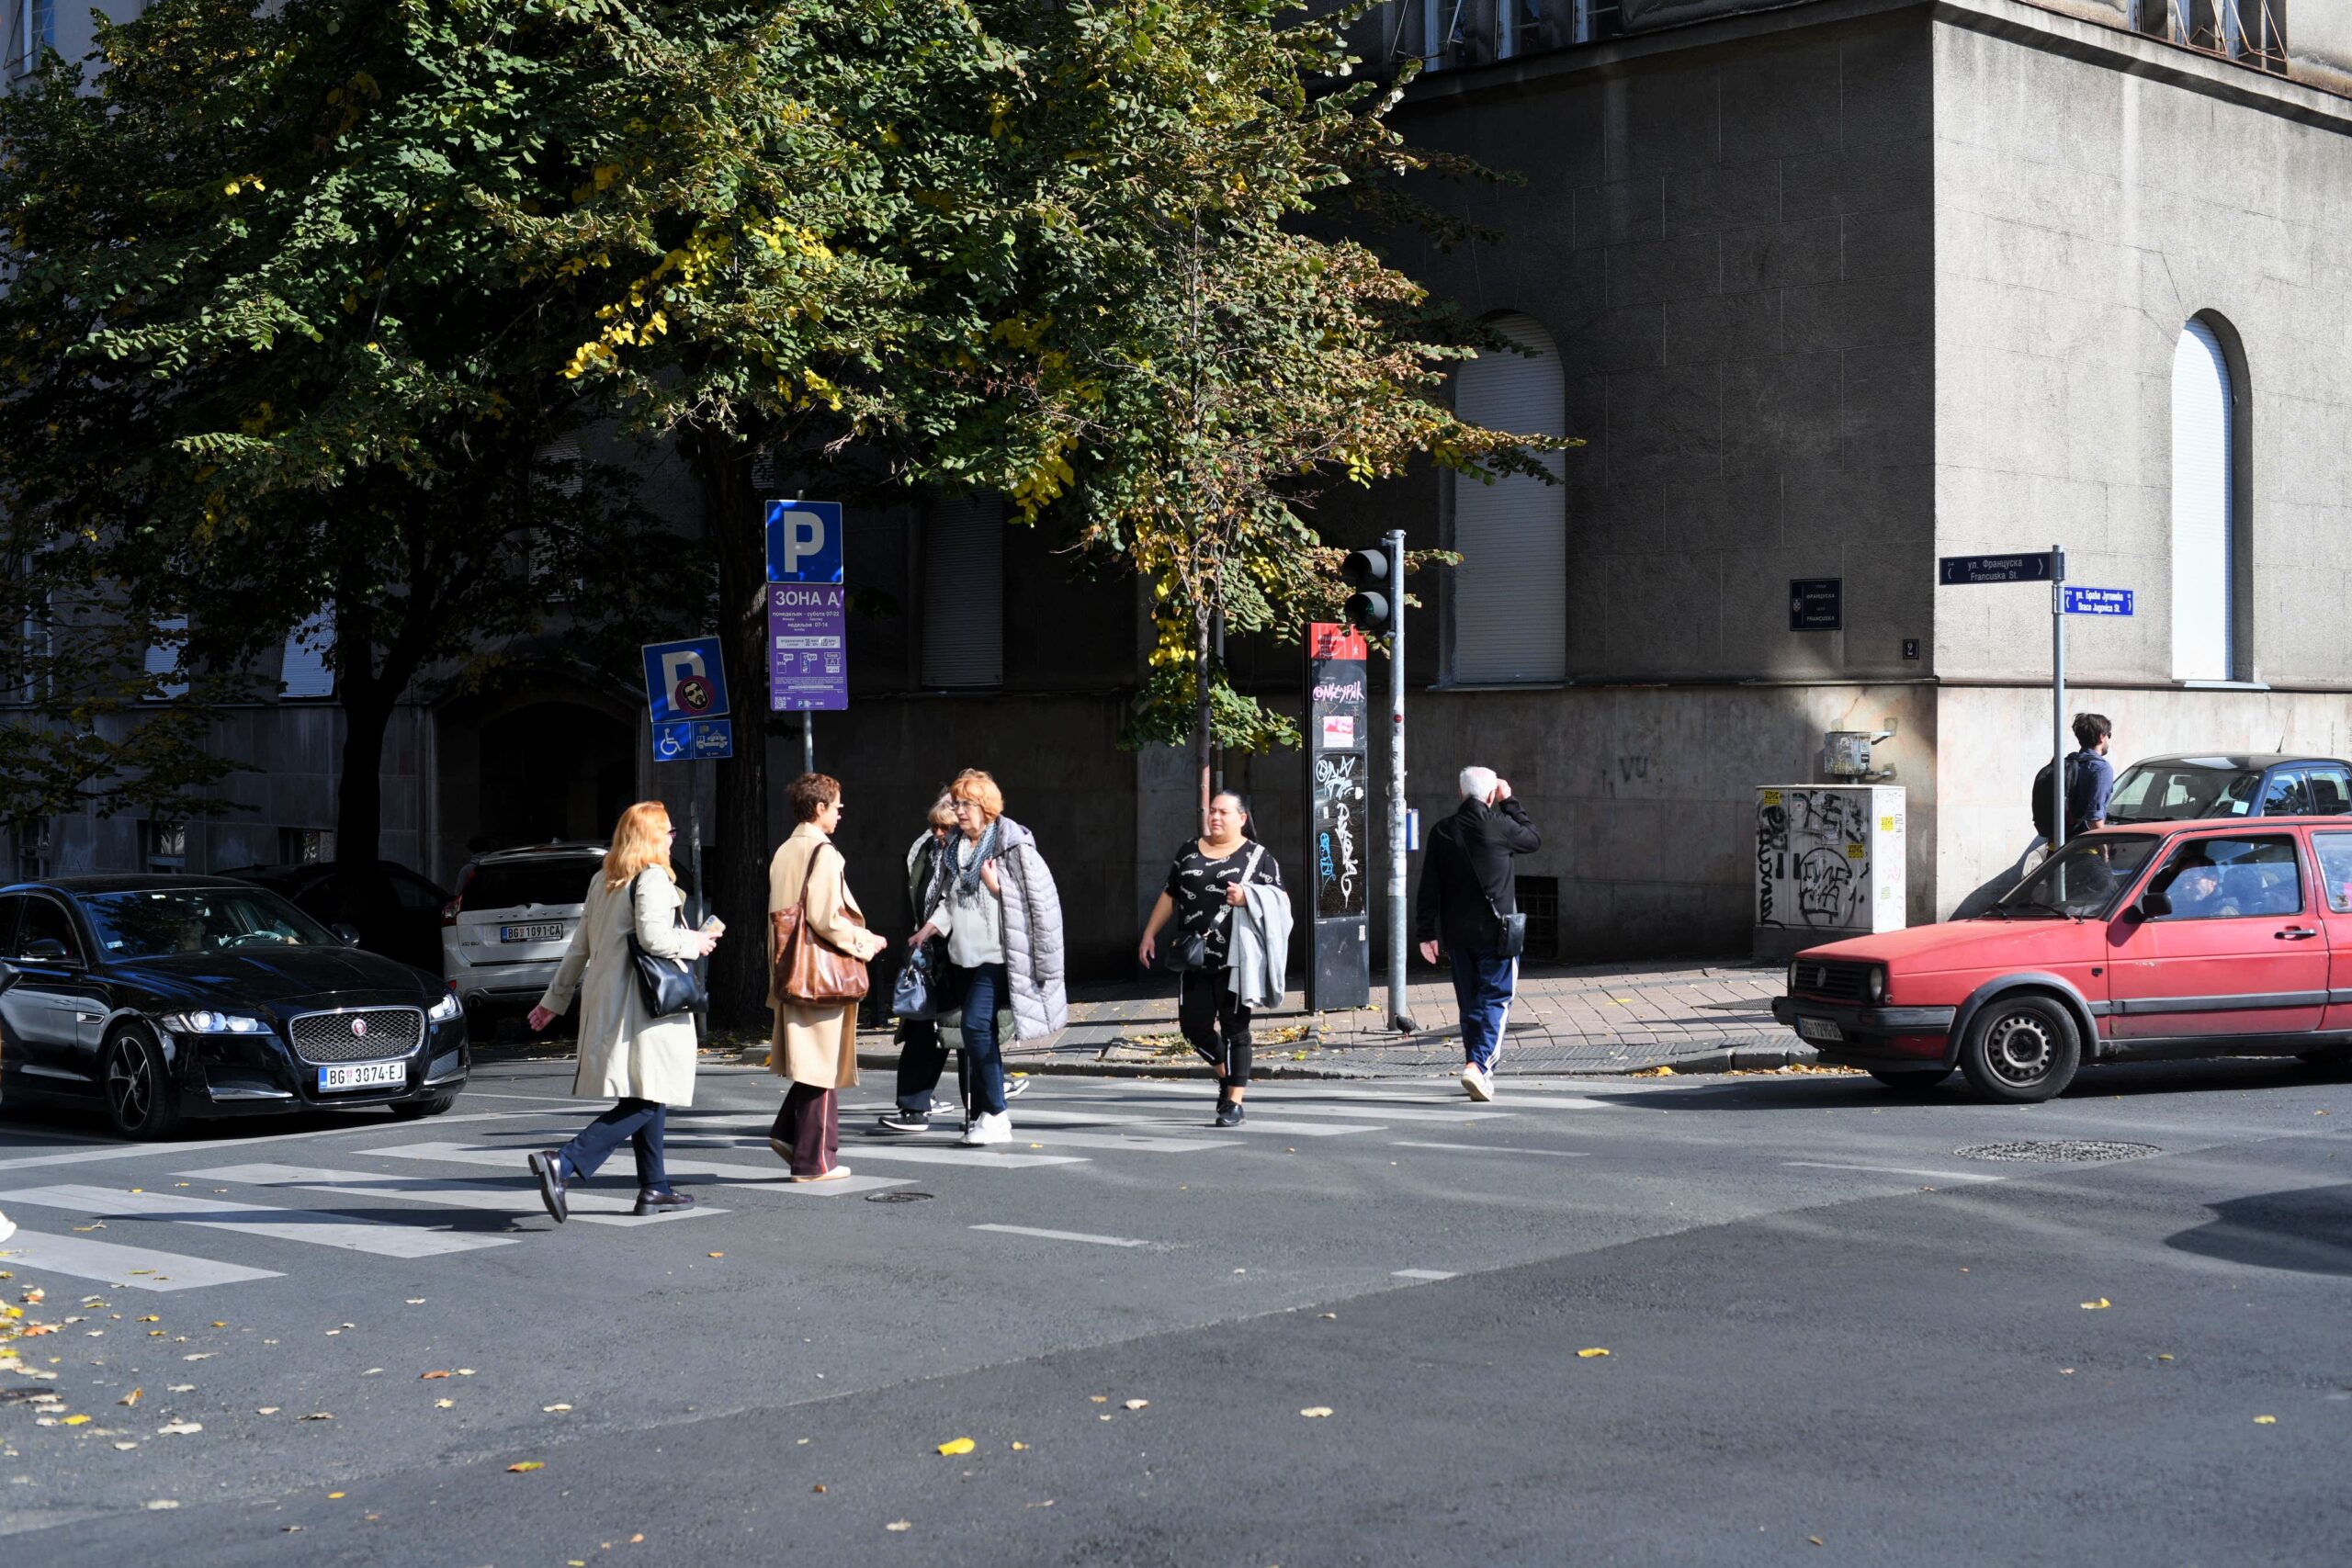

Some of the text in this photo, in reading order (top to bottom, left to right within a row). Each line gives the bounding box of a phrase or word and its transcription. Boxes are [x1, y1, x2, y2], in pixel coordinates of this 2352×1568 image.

[784, 511, 825, 573] P
[1967, 558, 2023, 570] ул. Француска
[1970, 570, 2018, 581] Francuska St.
[775, 591, 822, 606] ЗОНА
[1906, 642, 1914, 656] 2
[508, 928, 520, 938] BG
[329, 1069, 345, 1085] BG
